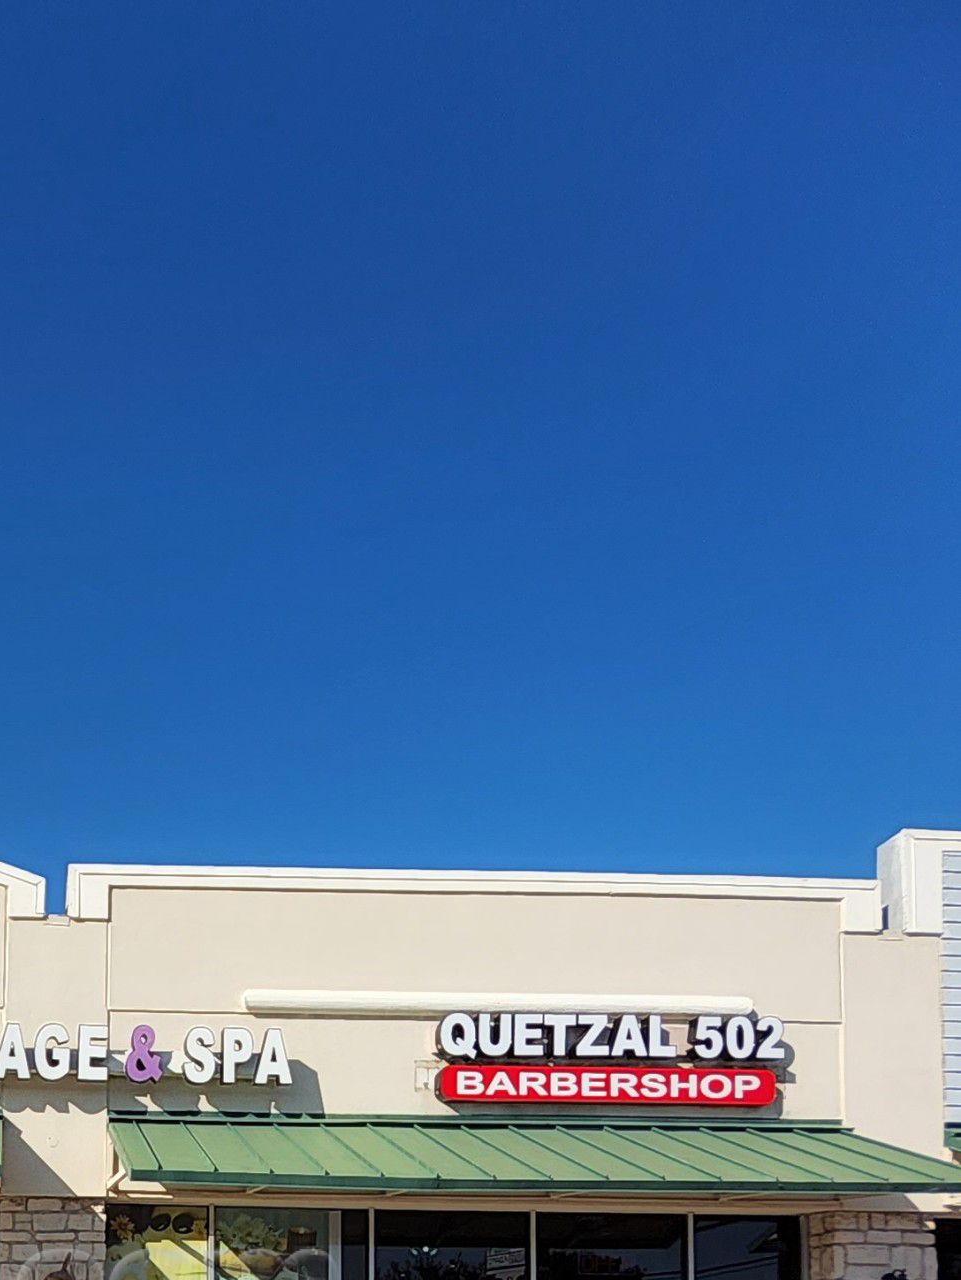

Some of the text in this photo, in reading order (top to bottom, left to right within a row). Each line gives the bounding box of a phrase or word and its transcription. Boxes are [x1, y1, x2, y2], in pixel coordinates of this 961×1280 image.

[124, 1024, 164, 1084] &
[183, 1026, 292, 1085] SPA
[440, 1012, 786, 1060] QUETZAL 502
[455, 1070, 762, 1099] BARBERSHOP
